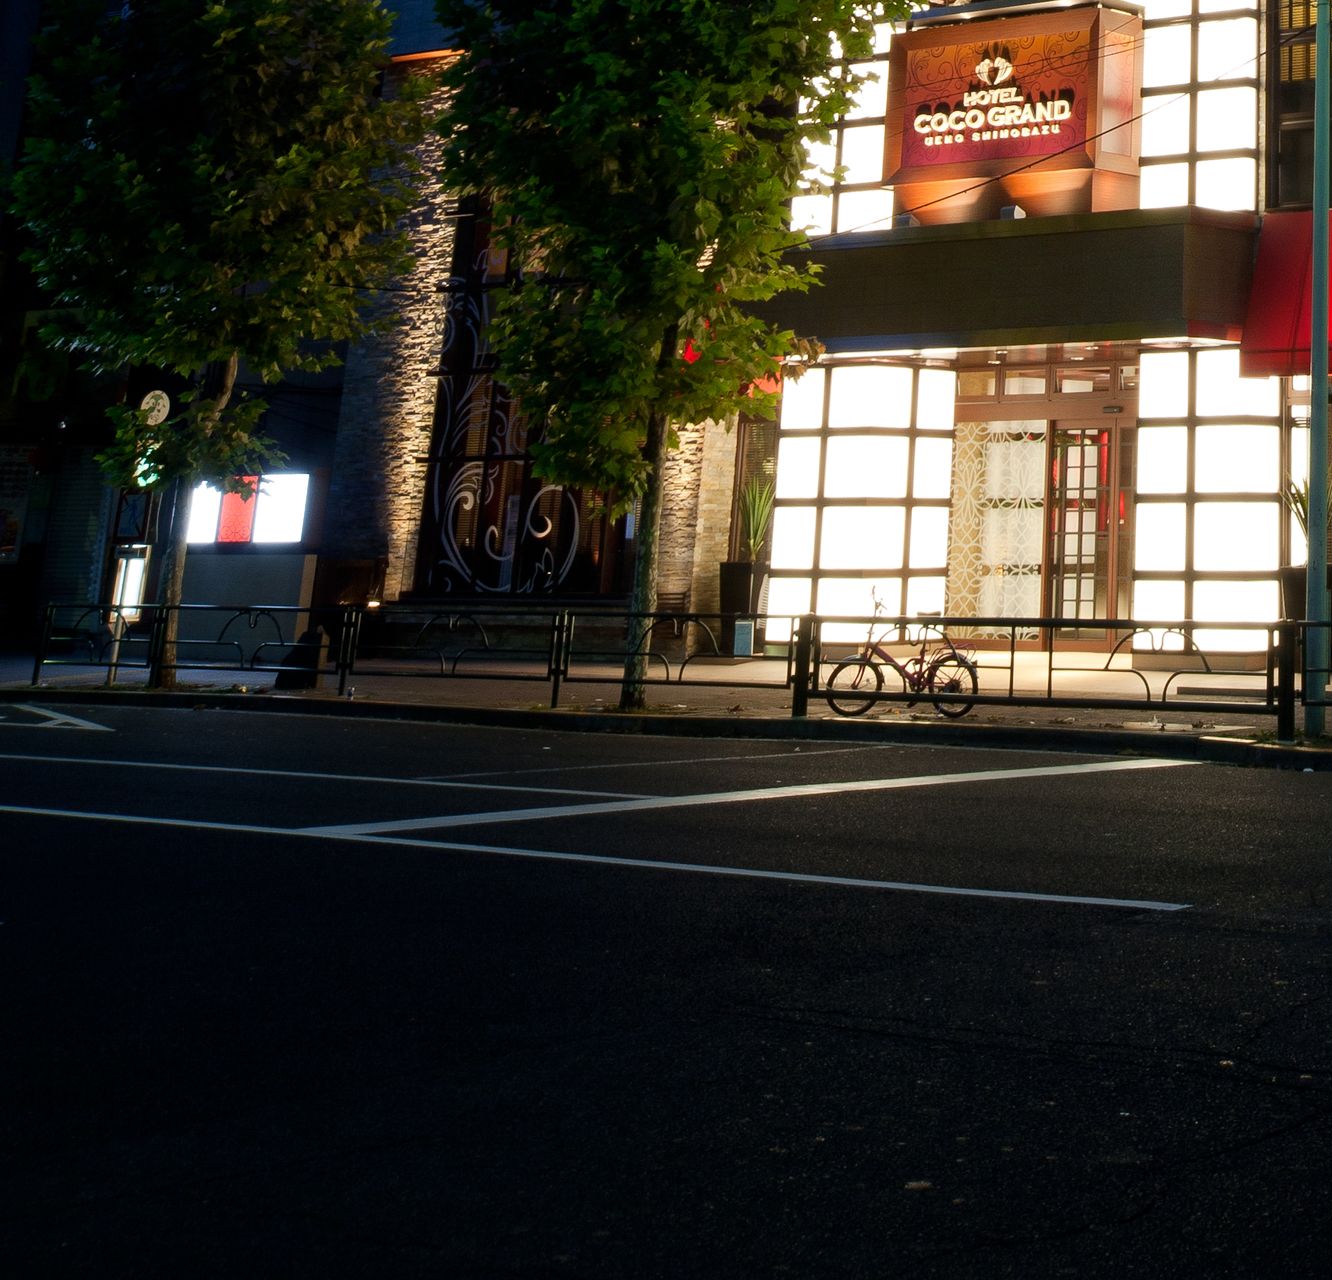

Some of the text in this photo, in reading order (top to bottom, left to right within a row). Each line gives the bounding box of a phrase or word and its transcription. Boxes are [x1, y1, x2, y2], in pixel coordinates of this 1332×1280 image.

[963, 87, 1024, 107] HOTEL
[913, 100, 1071, 133] COCO GRAND
[924, 124, 1061, 146] UENO SHINOBAZU
